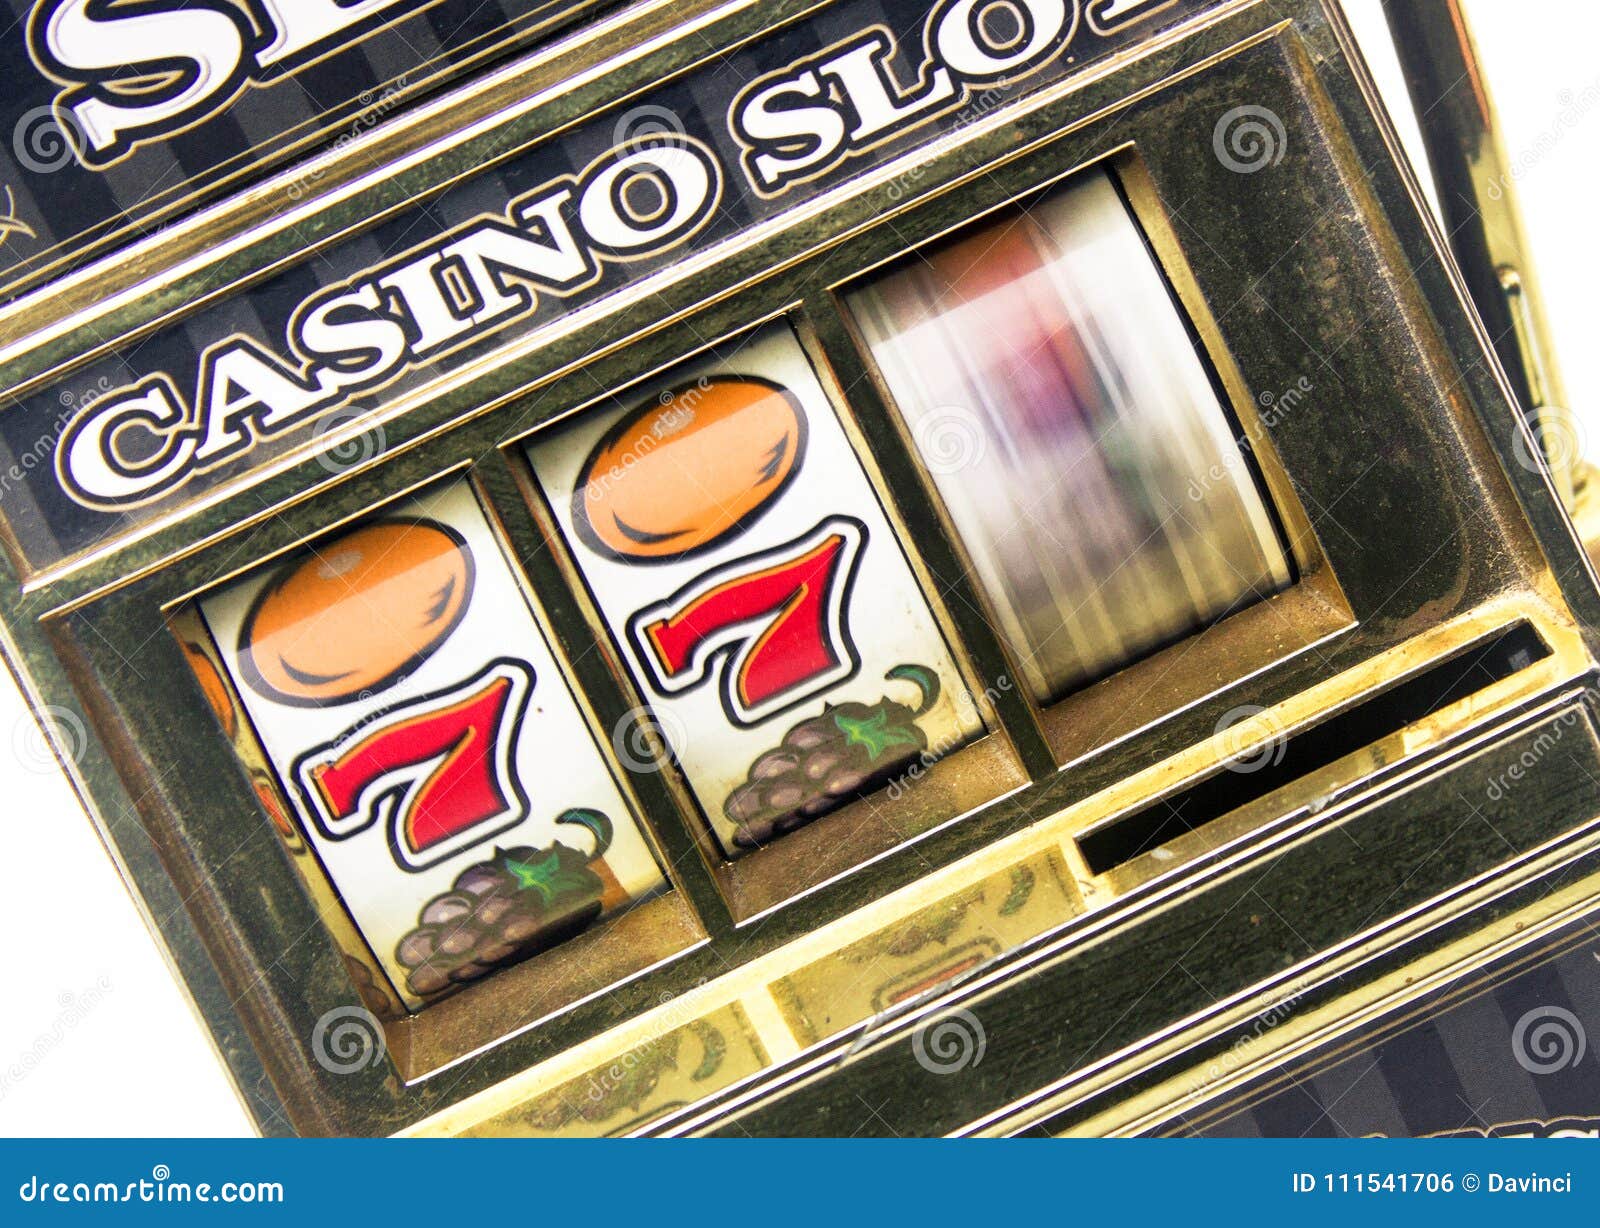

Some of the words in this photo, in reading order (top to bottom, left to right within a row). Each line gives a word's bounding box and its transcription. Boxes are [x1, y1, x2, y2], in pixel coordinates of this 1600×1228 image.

[62, 138, 715, 505] CASINO
[734, 0, 1150, 192] SLO
[634, 522, 860, 720] 7
[301, 665, 527, 863] 7
